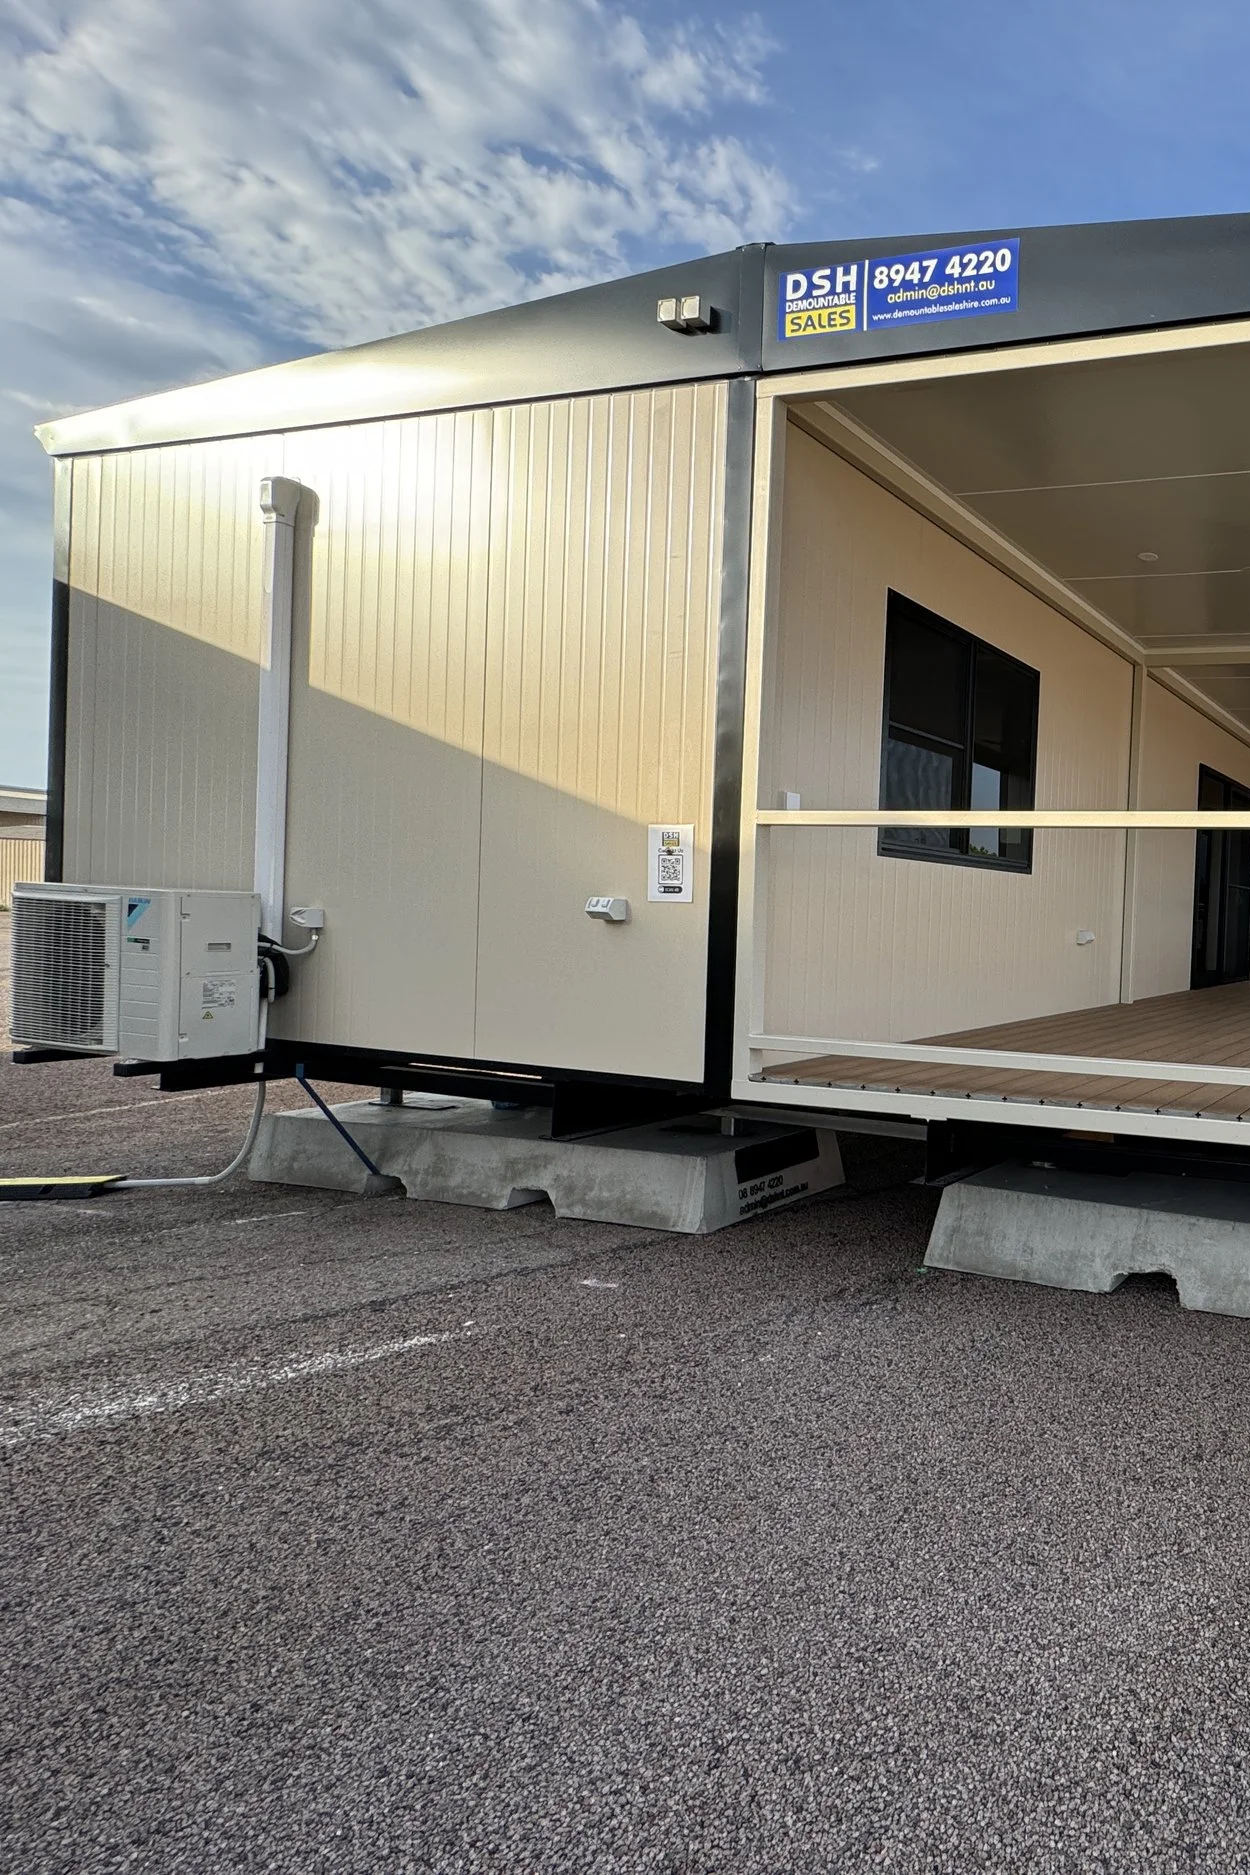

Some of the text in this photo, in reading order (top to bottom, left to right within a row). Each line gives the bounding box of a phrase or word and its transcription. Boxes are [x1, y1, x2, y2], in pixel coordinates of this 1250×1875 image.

[873, 248, 1012, 290] 8947 4220
[786, 265, 857, 301] DSH
[887, 280, 996, 304] admin@dshnt.au
[786, 293, 856, 313] DEMOUNTABLE
[872, 296, 1011, 321] www.demountablesaleshire.com.au
[790, 309, 851, 333] SALES
